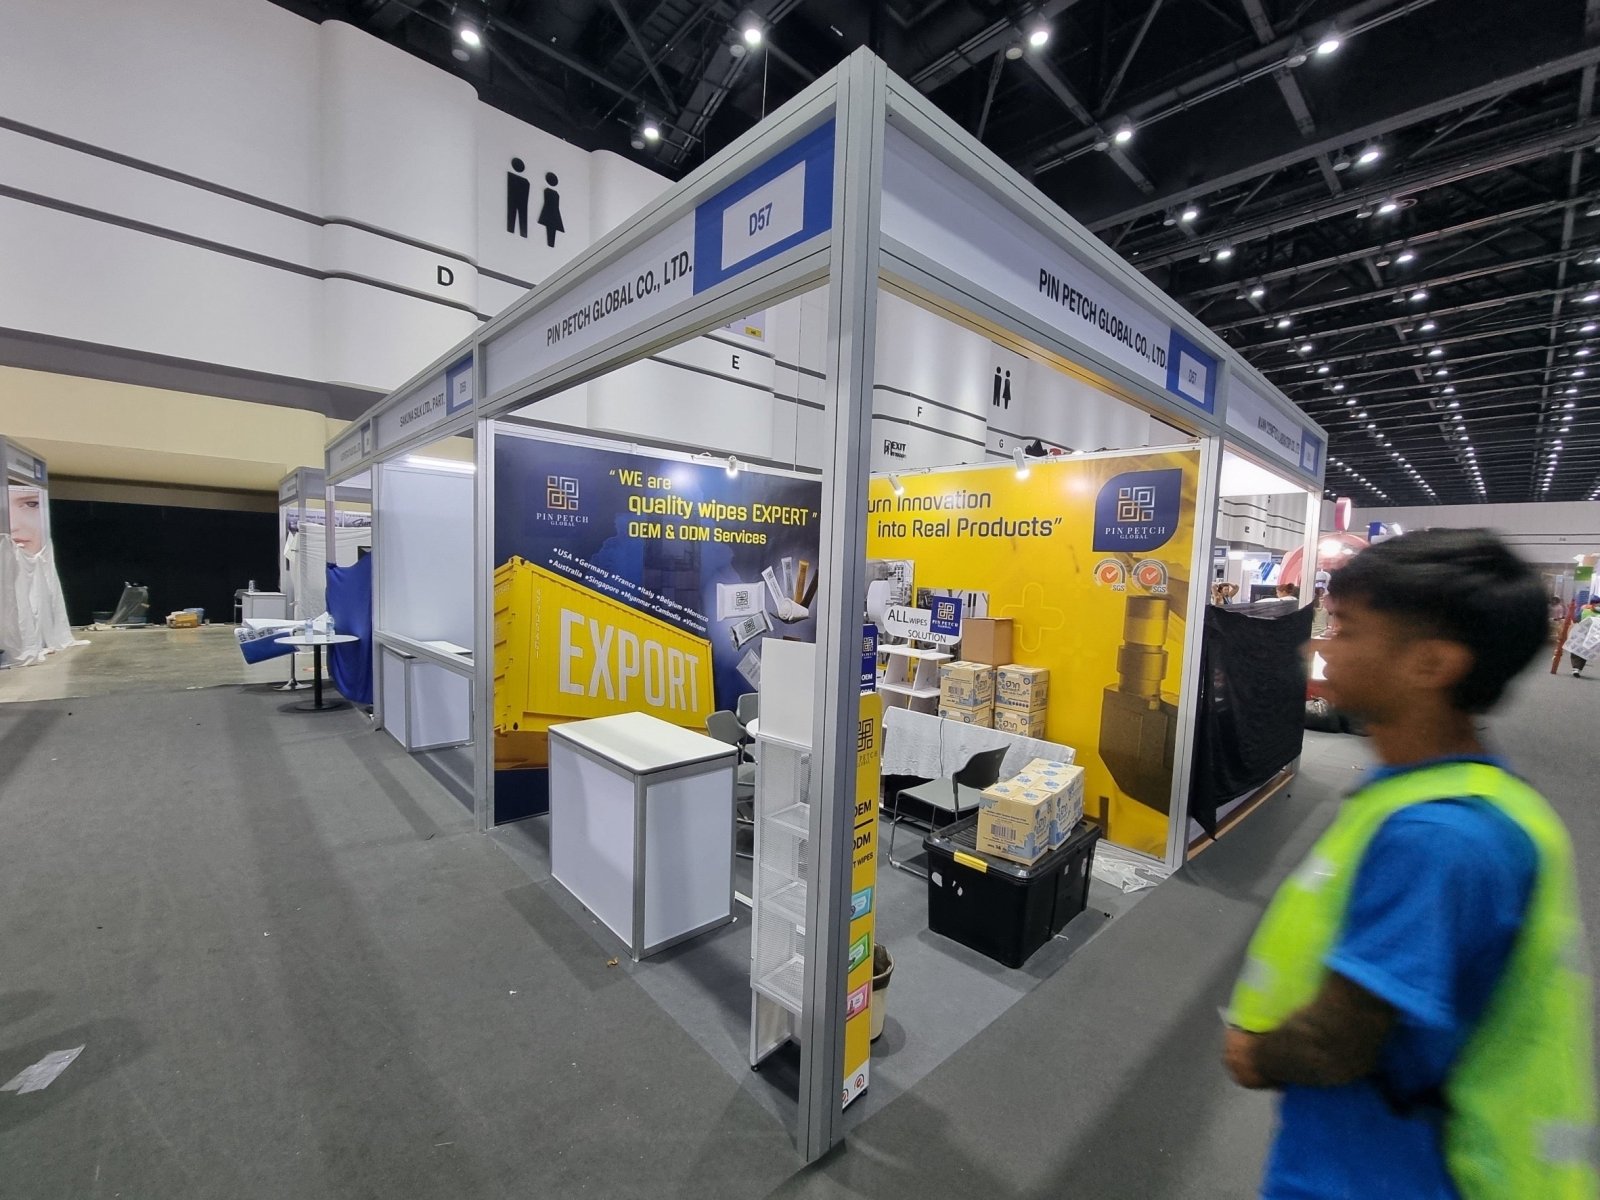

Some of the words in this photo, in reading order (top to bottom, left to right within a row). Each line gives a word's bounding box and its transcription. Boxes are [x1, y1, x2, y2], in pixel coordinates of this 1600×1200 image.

[750, 202, 772, 236] D57
[437, 265, 454, 286] D
[547, 324, 560, 346] PIN
[562, 305, 590, 339] PETCH
[592, 283, 634, 322] GLOBAL
[636, 270, 660, 300] CO.,
[664, 250, 692, 285] LTD.
[1039, 268, 1060, 302] PIN
[1062, 283, 1096, 325] PETCH
[1100, 308, 1134, 350] GLOBAL
[1135, 332, 1150, 363] CO.,
[1152, 344, 1167, 370] LTD.
[732, 355, 740, 370] E
[918, 406, 922, 418] F
[892, 442, 906, 452] EXIT
[648, 476, 672, 490] are
[628, 494, 694, 520] quality
[698, 500, 748, 522] wipes
[868, 498, 892, 513] urn
[897, 490, 991, 512] Innovation
[536, 512, 554, 520] PIN
[557, 514, 588, 523] PETCH
[628, 522, 660, 539] OEM
[666, 524, 675, 540] &
[680, 526, 710, 542] ODM
[714, 527, 766, 545] Services
[878, 520, 906, 538] into
[912, 519, 950, 538] Real
[1128, 526, 1165, 534] PETCH
[908, 630, 946, 643] SOLUTION
[560, 608, 698, 713] EXPORT
[857, 852, 873, 866] WIPES
